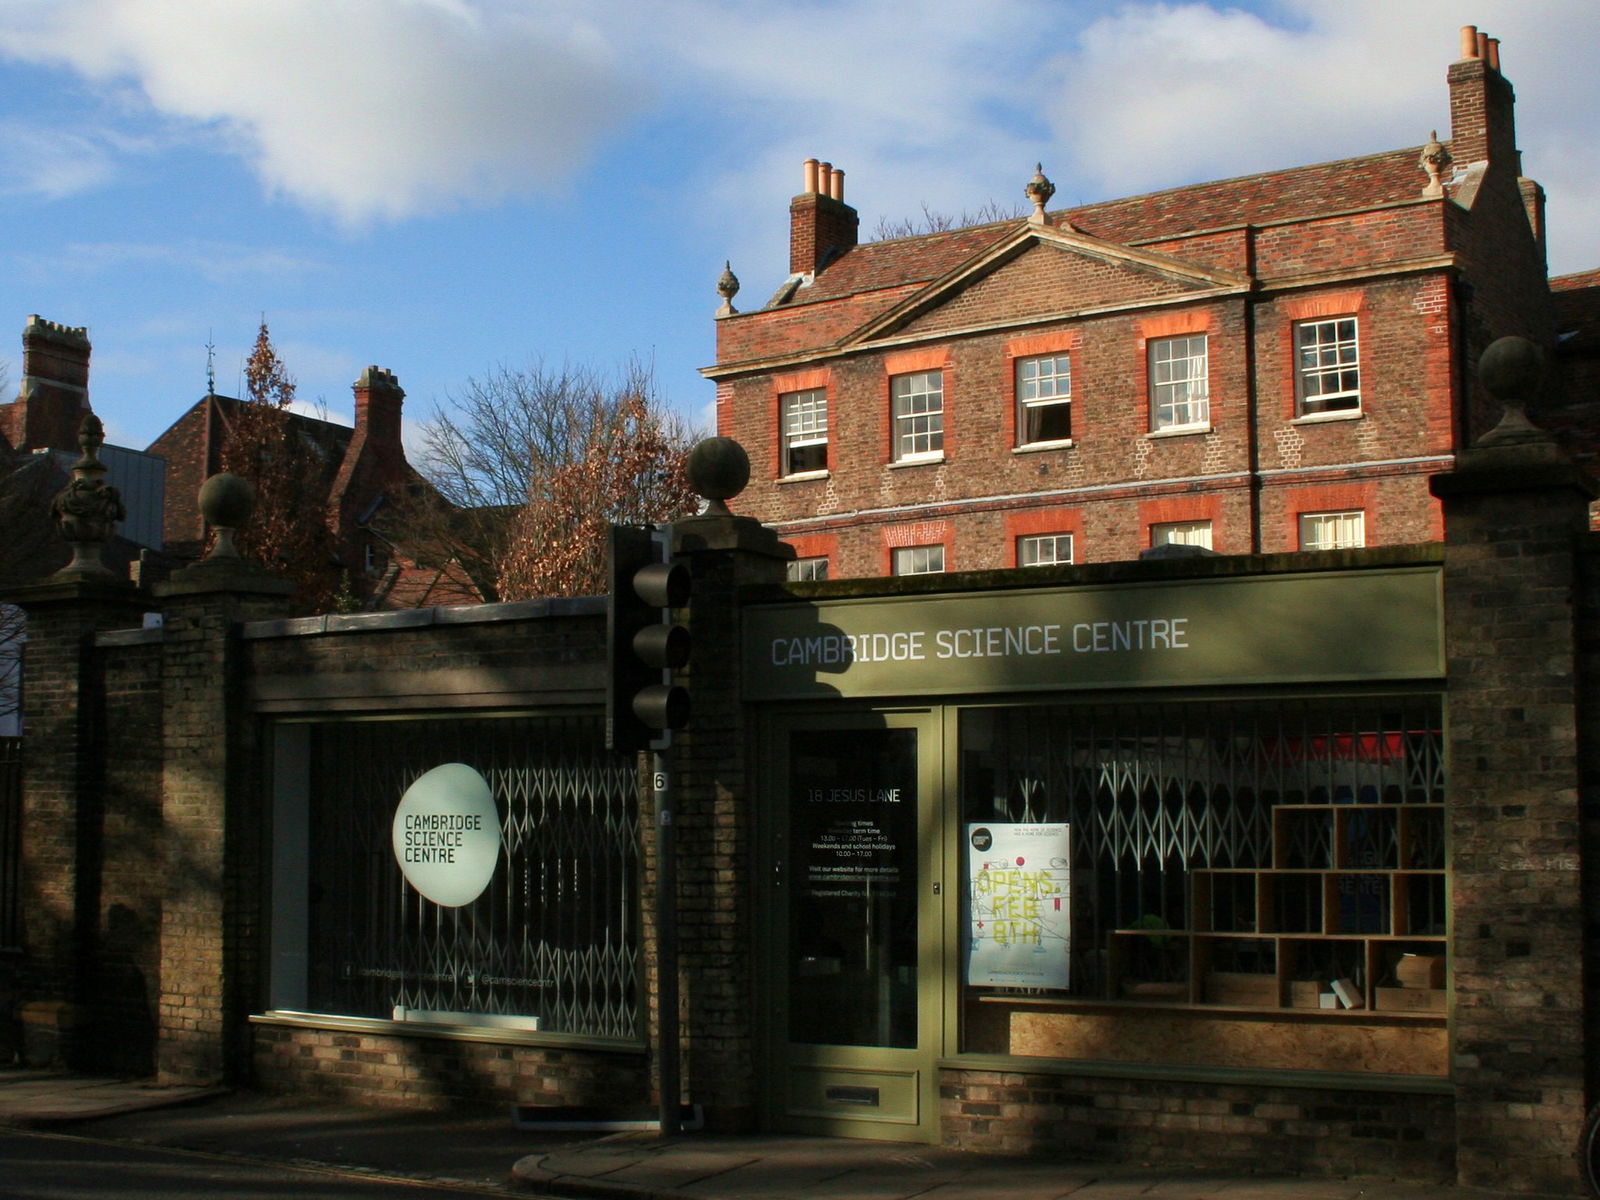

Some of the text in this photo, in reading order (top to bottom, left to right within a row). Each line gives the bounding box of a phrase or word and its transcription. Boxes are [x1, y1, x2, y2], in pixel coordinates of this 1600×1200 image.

[771, 618, 1190, 667] CAMBRIDGE SCIENCE CENTRE
[655, 774, 665, 789] 6
[808, 788, 901, 803] 18 JESUS LANE
[405, 814, 482, 831] CAMBRIDGE
[405, 831, 463, 847] SCIENCE
[872, 843, 896, 851] holidays
[405, 848, 456, 864] CENTRE
[977, 871, 1054, 894] OPENS
[992, 896, 1039, 919] FEB
[993, 922, 1039, 945] 8TH
